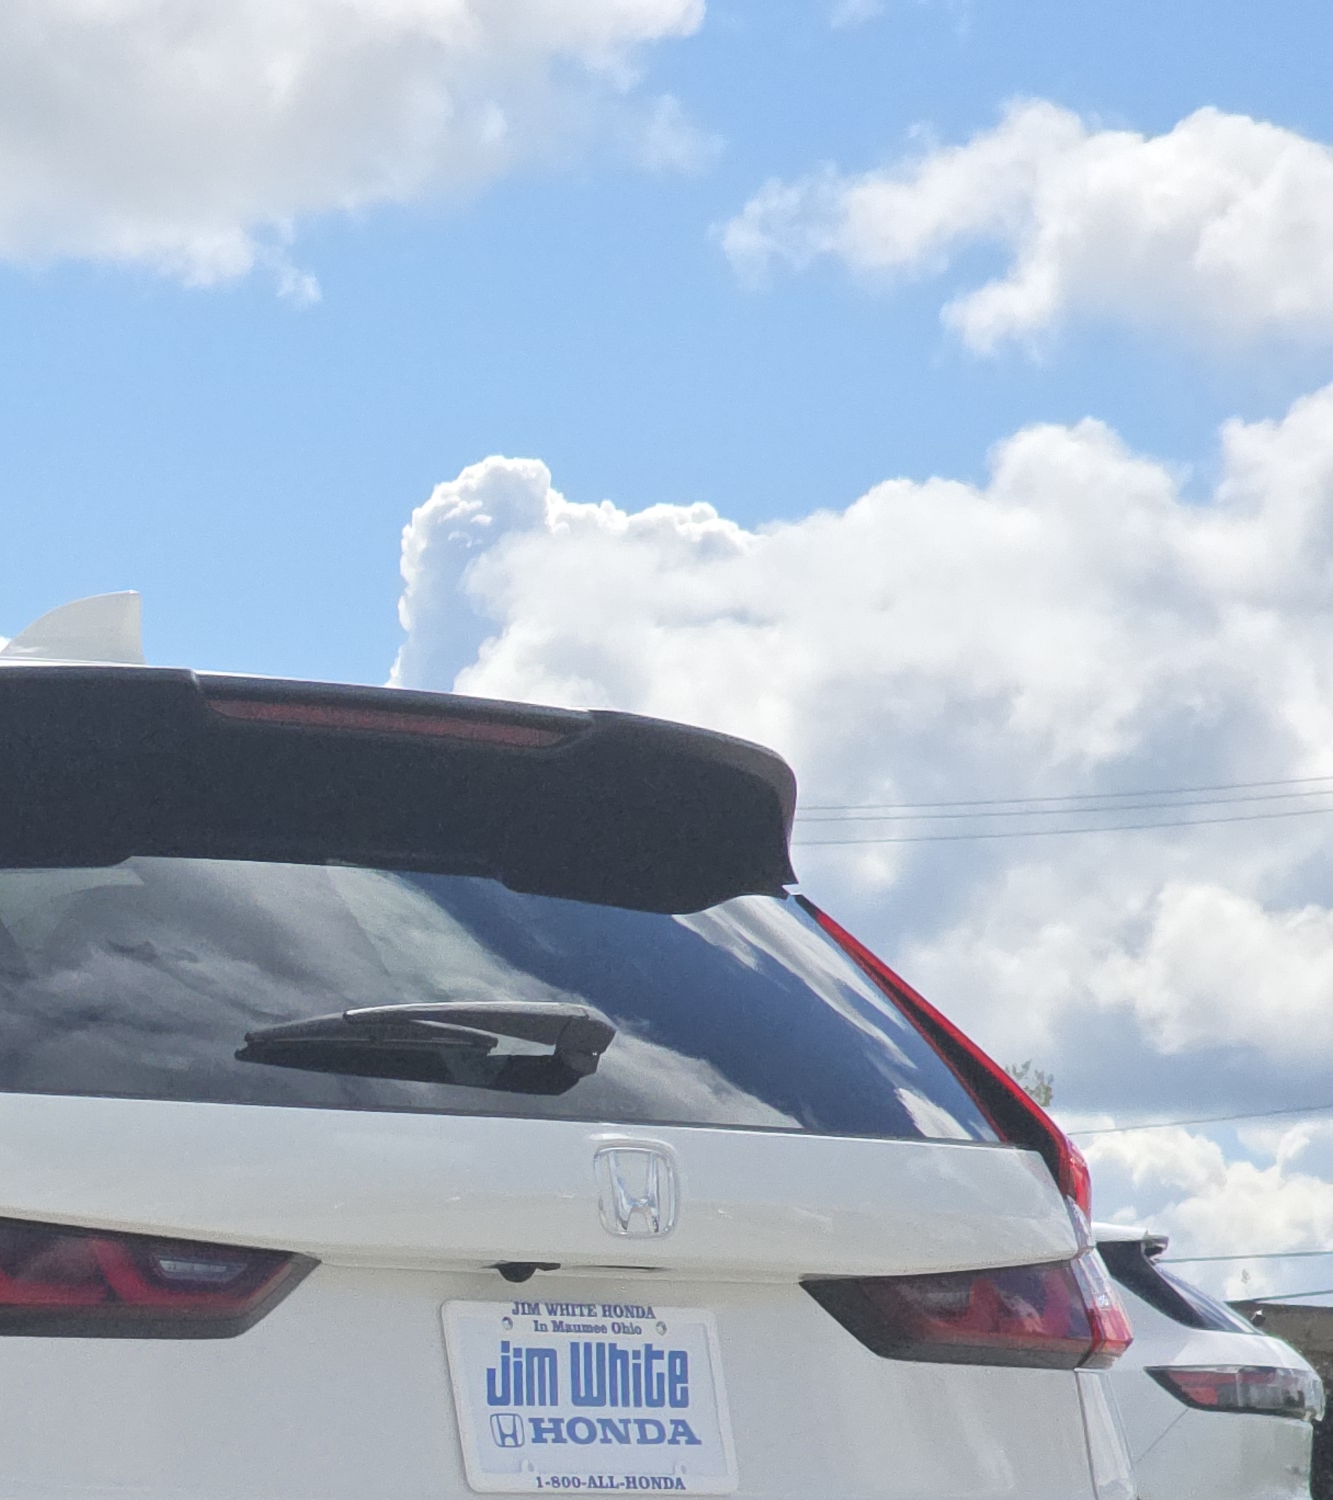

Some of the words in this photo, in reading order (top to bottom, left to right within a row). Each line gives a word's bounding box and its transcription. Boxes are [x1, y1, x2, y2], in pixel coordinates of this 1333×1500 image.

[512, 1302, 542, 1316] JIM
[545, 1303, 597, 1318] WHITE
[601, 1305, 656, 1319] HONDA
[533, 1320, 548, 1333] In
[551, 1320, 608, 1334] Maumee
[611, 1322, 642, 1335] Ohio
[569, 1342, 689, 1409] White
[528, 1417, 702, 1445] HONDA
[536, 1476, 686, 1491] 1-800-ALL-HONDA
